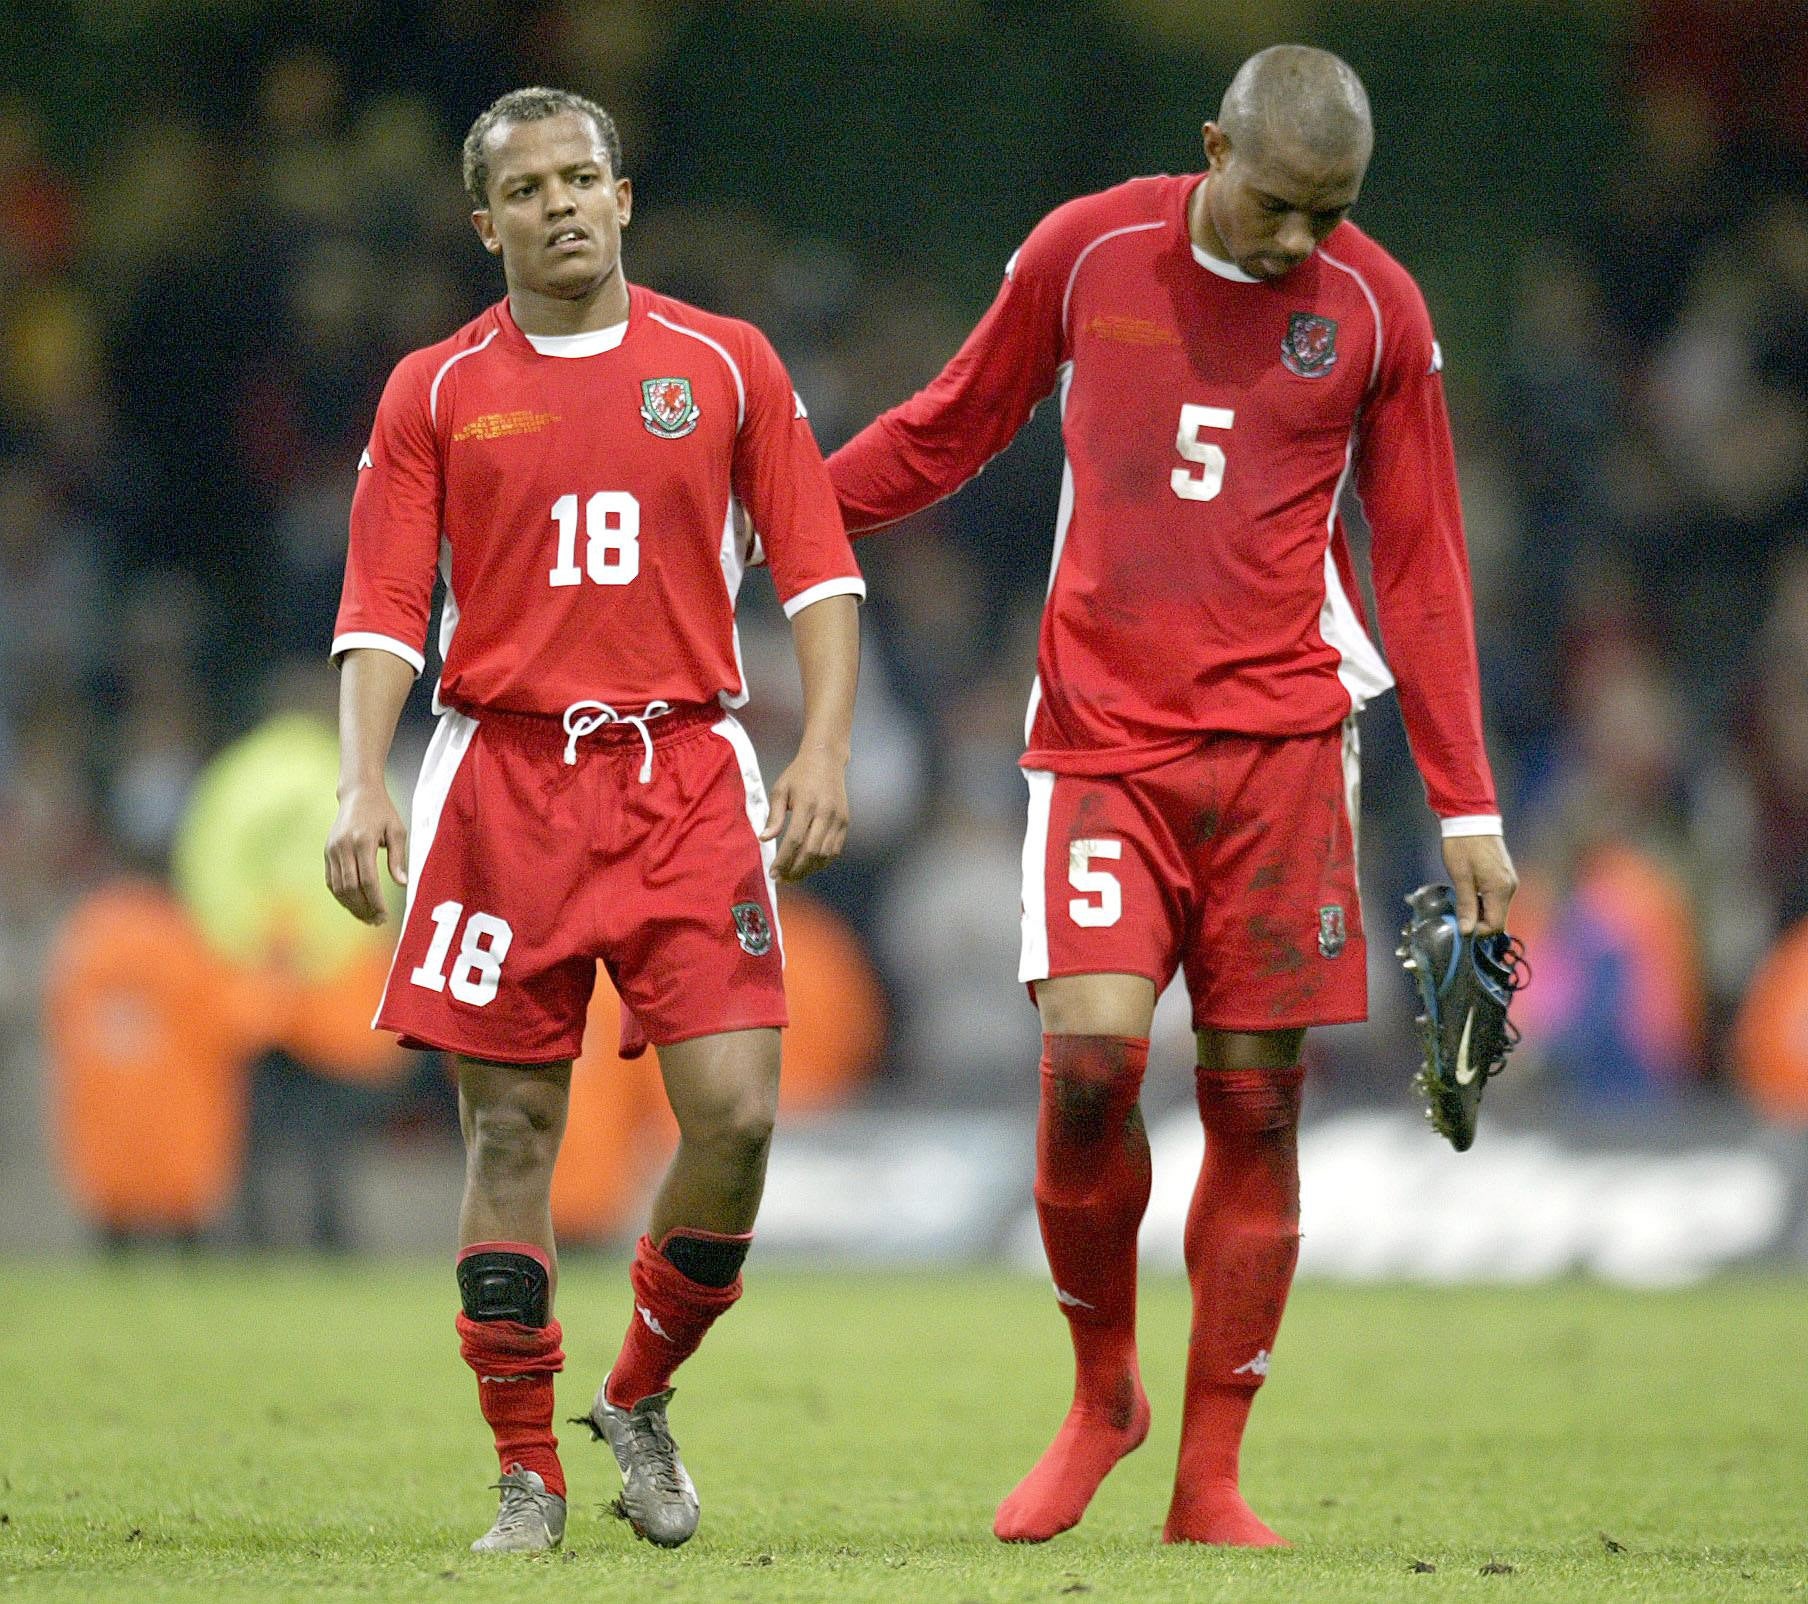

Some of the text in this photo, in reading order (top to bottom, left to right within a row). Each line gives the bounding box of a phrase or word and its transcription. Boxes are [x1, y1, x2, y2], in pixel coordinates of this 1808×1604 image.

[1171, 404, 1235, 501] 5
[549, 491, 640, 587] 18
[1069, 838, 1122, 928] 5
[410, 900, 514, 1007] 18
